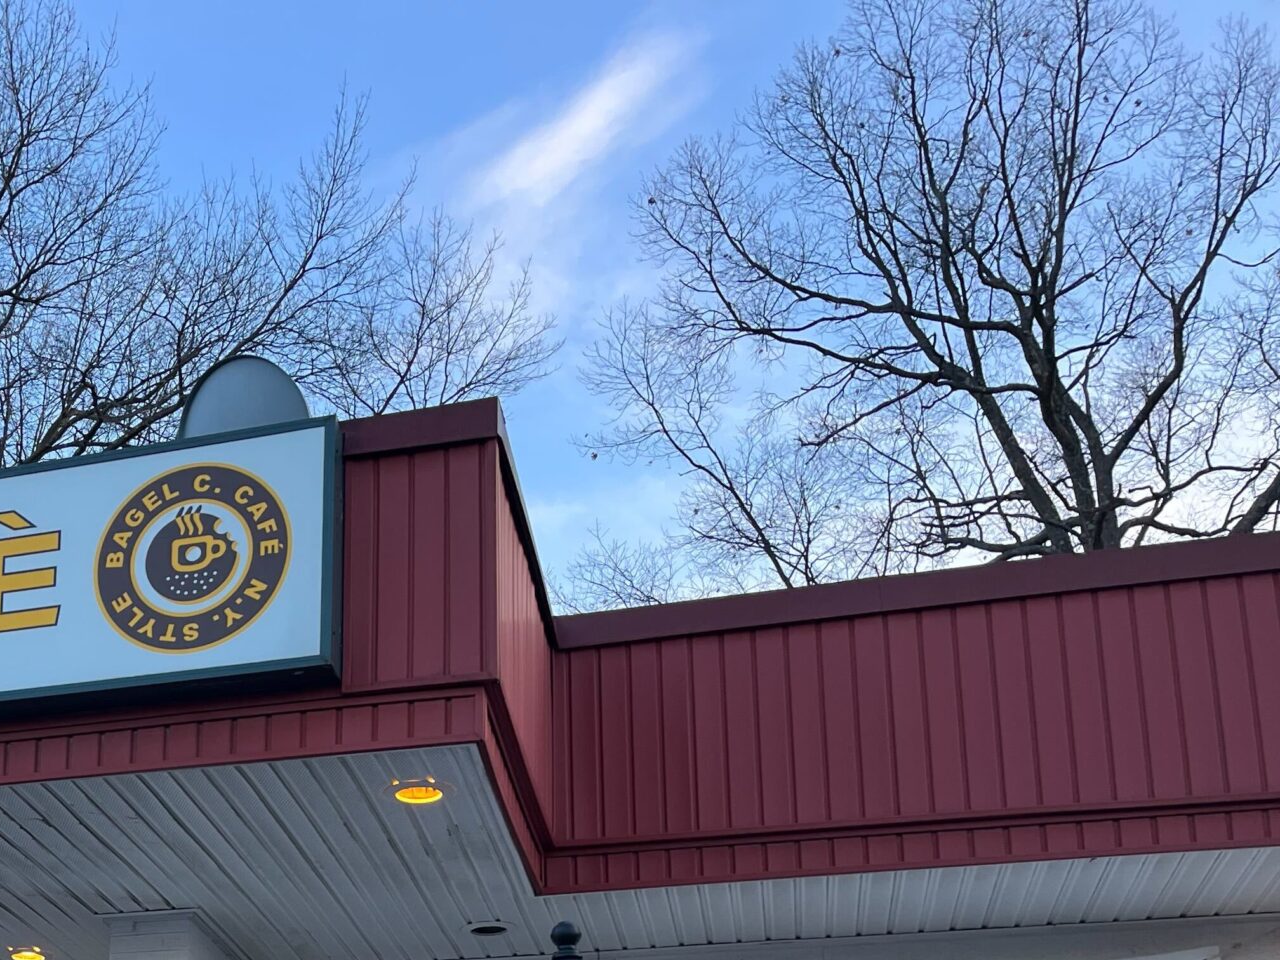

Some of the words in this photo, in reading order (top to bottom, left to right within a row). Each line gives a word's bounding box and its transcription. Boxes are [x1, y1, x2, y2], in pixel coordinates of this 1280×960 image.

[106, 483, 179, 568] BAGEL
[193, 474, 221, 493] C.
[111, 592, 200, 642] STYLE
[212, 578, 268, 627] N.Y.
